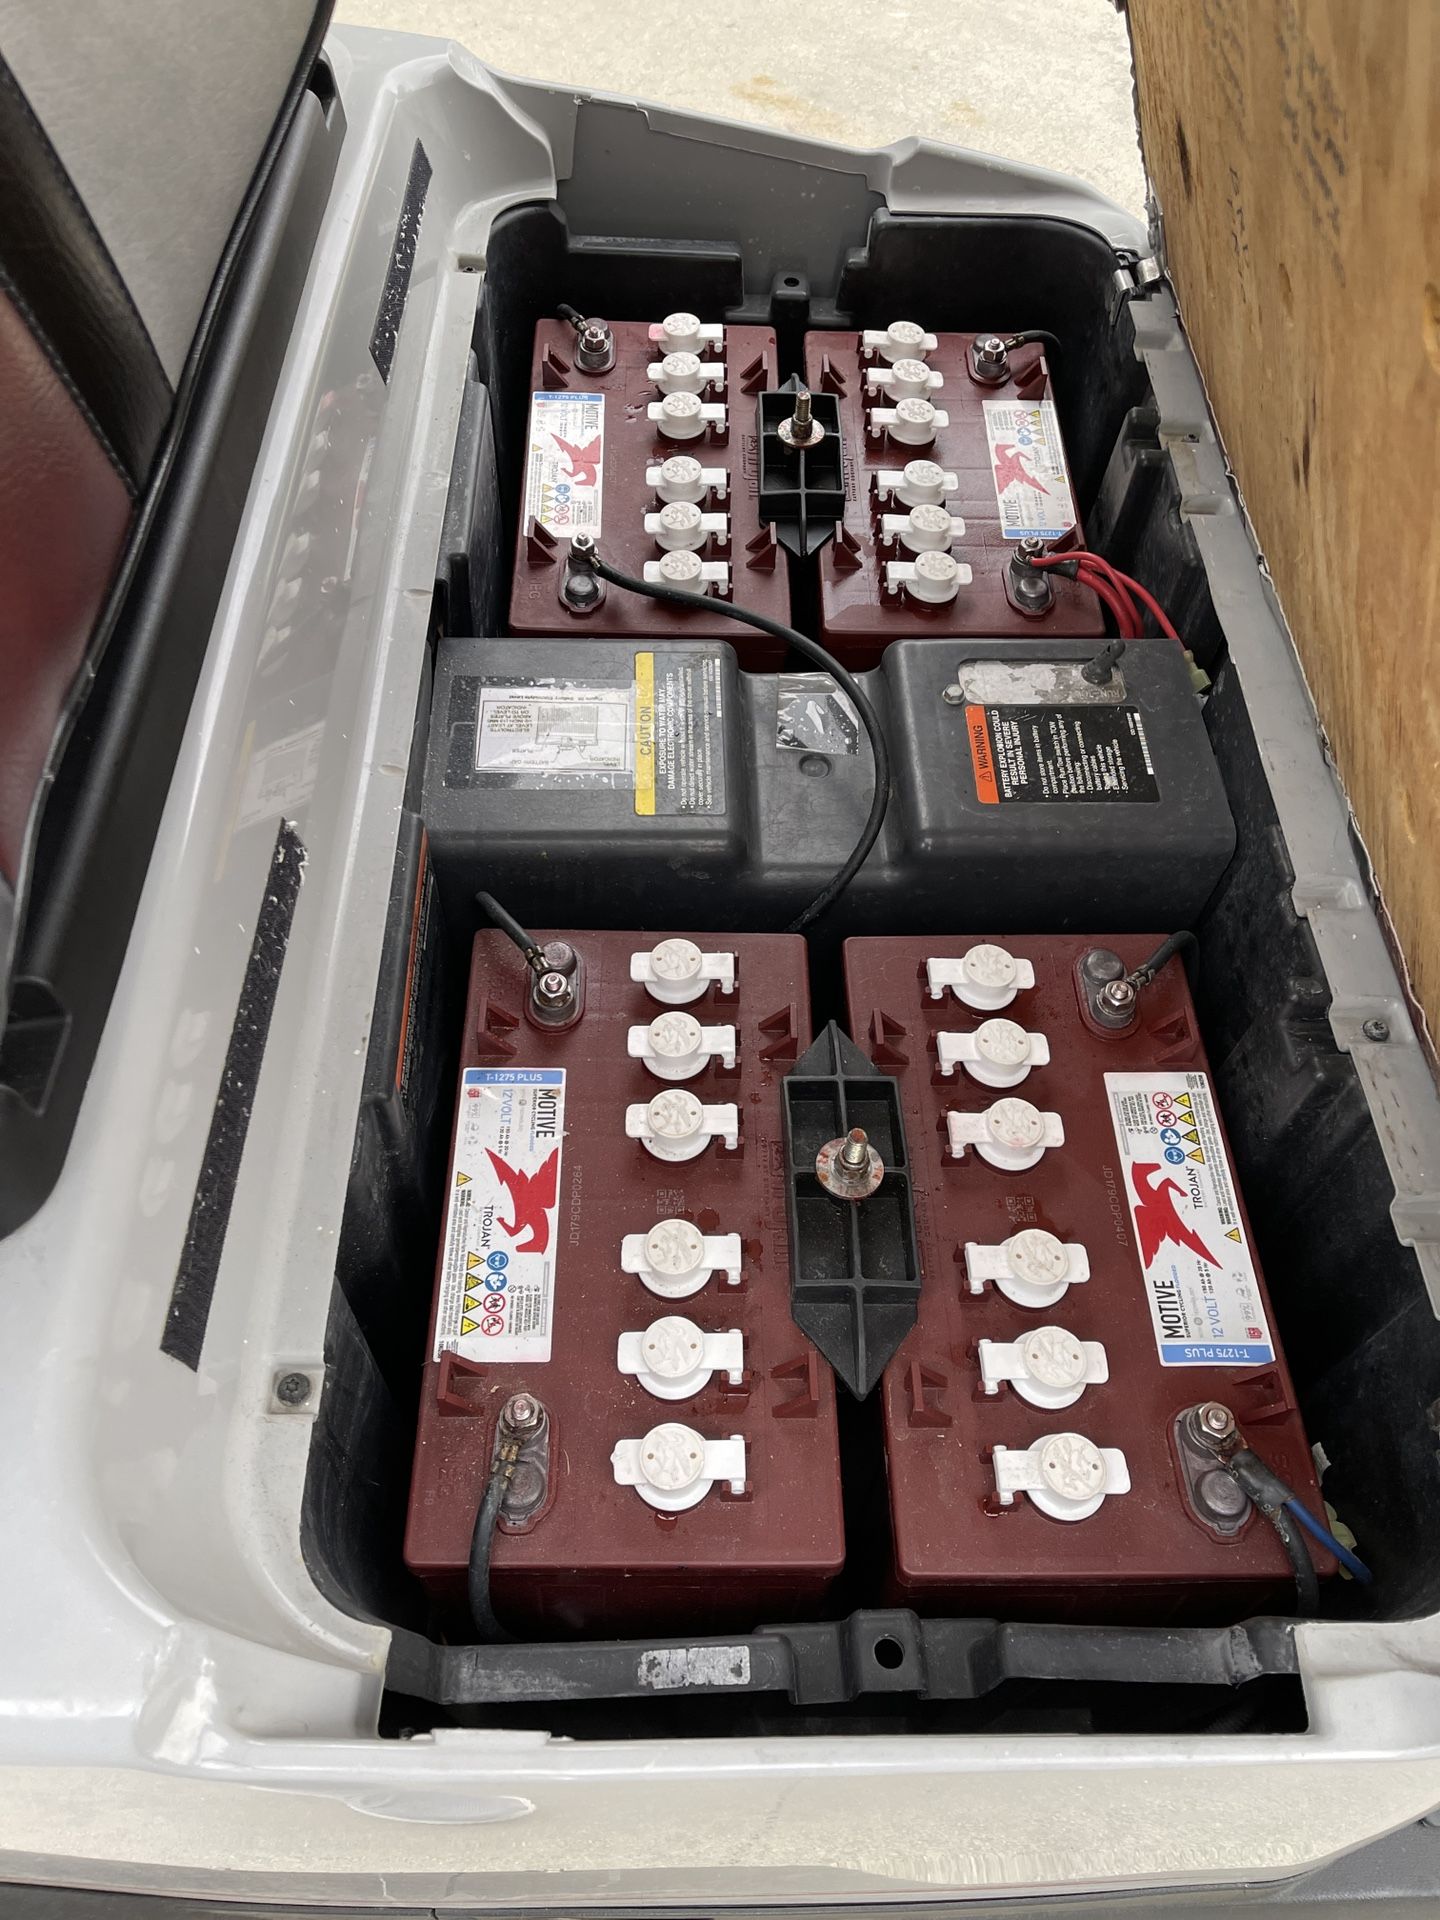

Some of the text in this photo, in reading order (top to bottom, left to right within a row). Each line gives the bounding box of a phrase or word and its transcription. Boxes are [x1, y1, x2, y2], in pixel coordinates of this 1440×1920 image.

[585, 403, 598, 429] MOTIVE
[1003, 499, 1020, 526] MOTIVE
[665, 672, 673, 716] COMPONENTS
[639, 706, 651, 755] CAUTON
[658, 727, 666, 736] TO
[1002, 721, 1013, 748] SEVERE
[1031, 725, 1041, 742] battery
[1049, 721, 1057, 734] TOW
[1074, 720, 1086, 748] connecting
[658, 738, 666, 774] EXPOSURE
[973, 724, 989, 769] WARNING
[991, 709, 1012, 797] BATTERY EXPLOSION COULD
[1010, 720, 1028, 784] PERSONAL INJURY
[1096, 743, 1105, 761] vehicle
[1112, 738, 1121, 756] vehicle
[667, 760, 675, 789] DAMAGE
[1008, 758, 1019, 785] RESULT
[1081, 754, 1095, 790] Disconnecting
[1093, 772, 1104, 790] battery
[1117, 766, 1130, 790] Servicing
[1060, 779, 1069, 793] Place
[485, 1072, 543, 1081] T-1275 PLUS
[499, 1098, 513, 1124] VOLT
[534, 1088, 558, 1138] MOTIVE
[1186, 1168, 1204, 1209] TROJAN
[479, 1205, 493, 1246] TROJAN
[1153, 1279, 1185, 1338] MOTIVE
[1177, 1289, 1185, 1311] CYCLING
[1182, 1312, 1191, 1337] SUPERIOR
[1203, 1295, 1224, 1338] 12 VOLT
[1184, 1346, 1250, 1359] T-1275 PLUS
